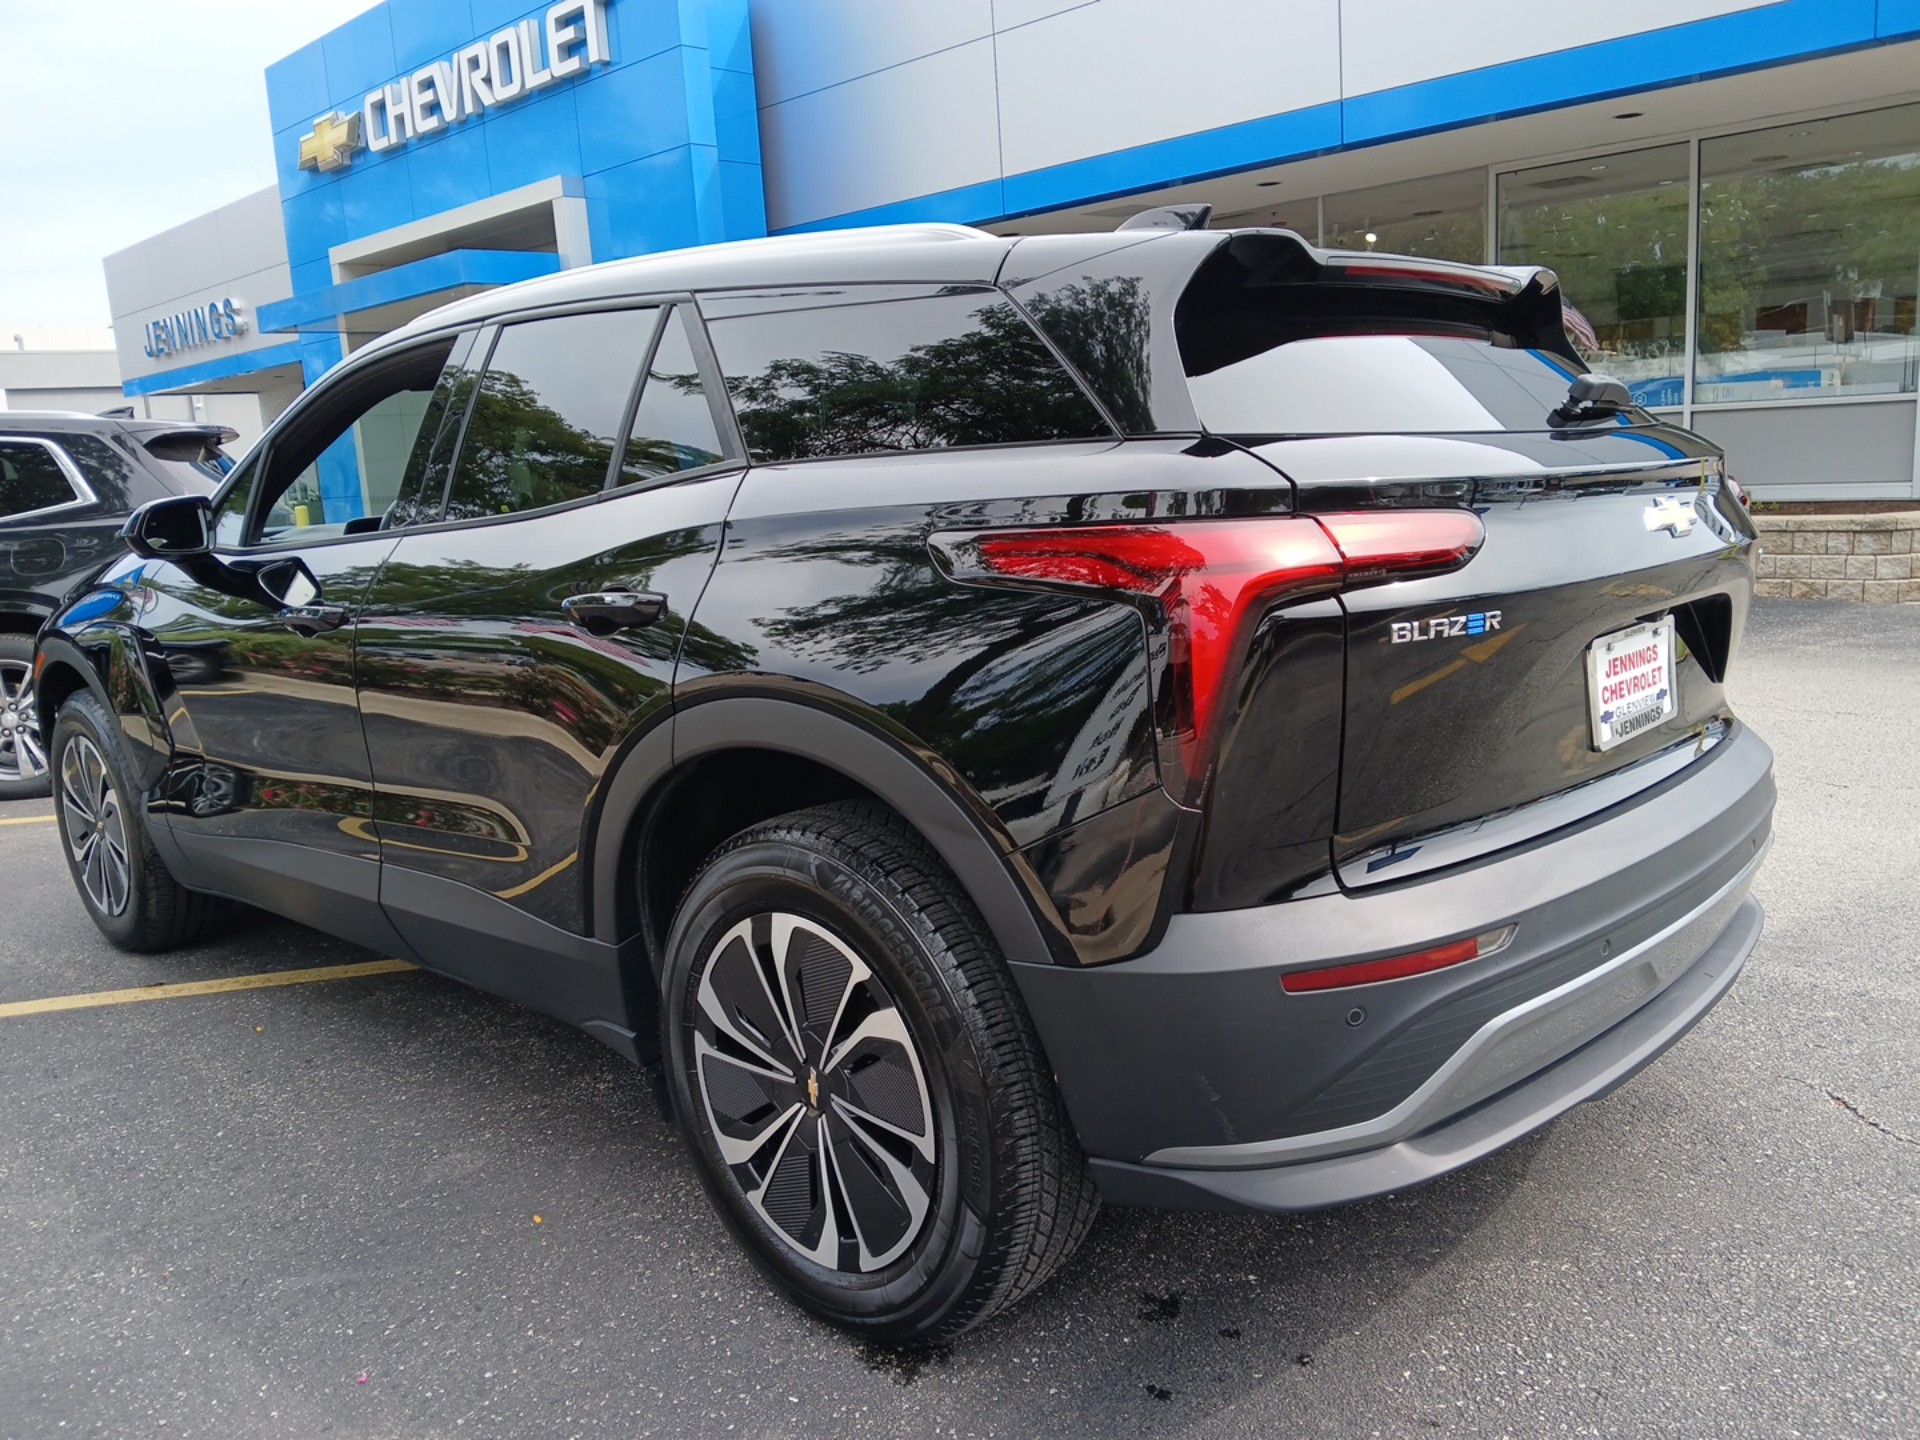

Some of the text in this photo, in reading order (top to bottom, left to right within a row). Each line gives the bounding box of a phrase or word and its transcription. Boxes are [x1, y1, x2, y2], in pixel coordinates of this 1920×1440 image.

[364, 0, 609, 152] CHEVROLET
[144, 298, 240, 358] JENNINGS
[1391, 610, 1502, 643] BLAZER
[1605, 644, 1659, 679] JENNINGS
[1602, 666, 1663, 704] CHEVROLET
[1615, 693, 1657, 718] GLENVIEW
[1618, 706, 1661, 737] JENNINGS
